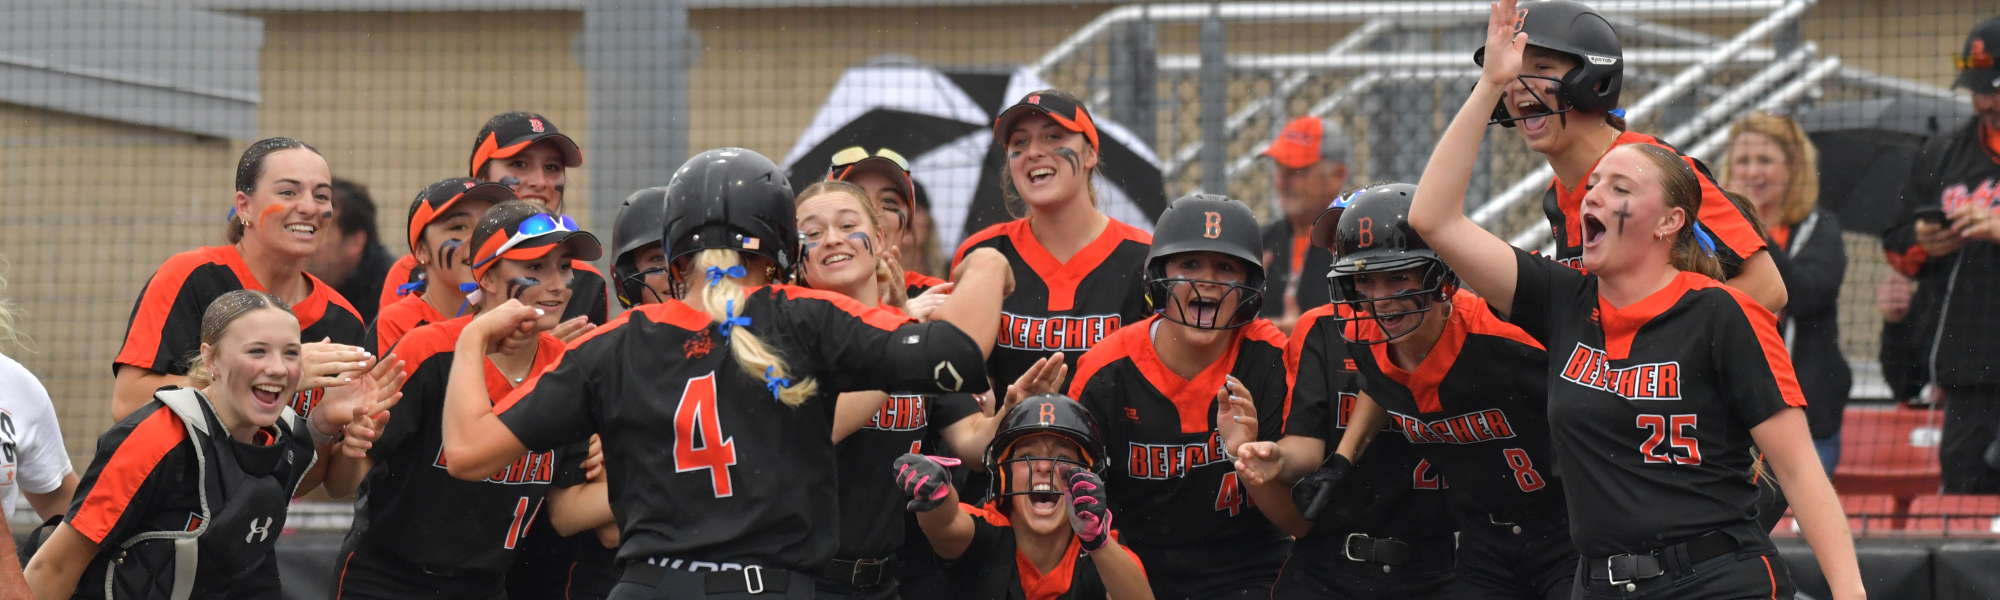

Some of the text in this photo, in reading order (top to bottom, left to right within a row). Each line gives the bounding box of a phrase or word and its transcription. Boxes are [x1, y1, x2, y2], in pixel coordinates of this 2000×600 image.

[529, 118, 545, 133] B
[1204, 211, 1221, 239] B
[1358, 216, 1374, 248] B
[1039, 402, 1055, 425] B
[673, 370, 737, 498] 4
[1636, 414, 1701, 465] 25
[1503, 448, 1546, 492] 8
